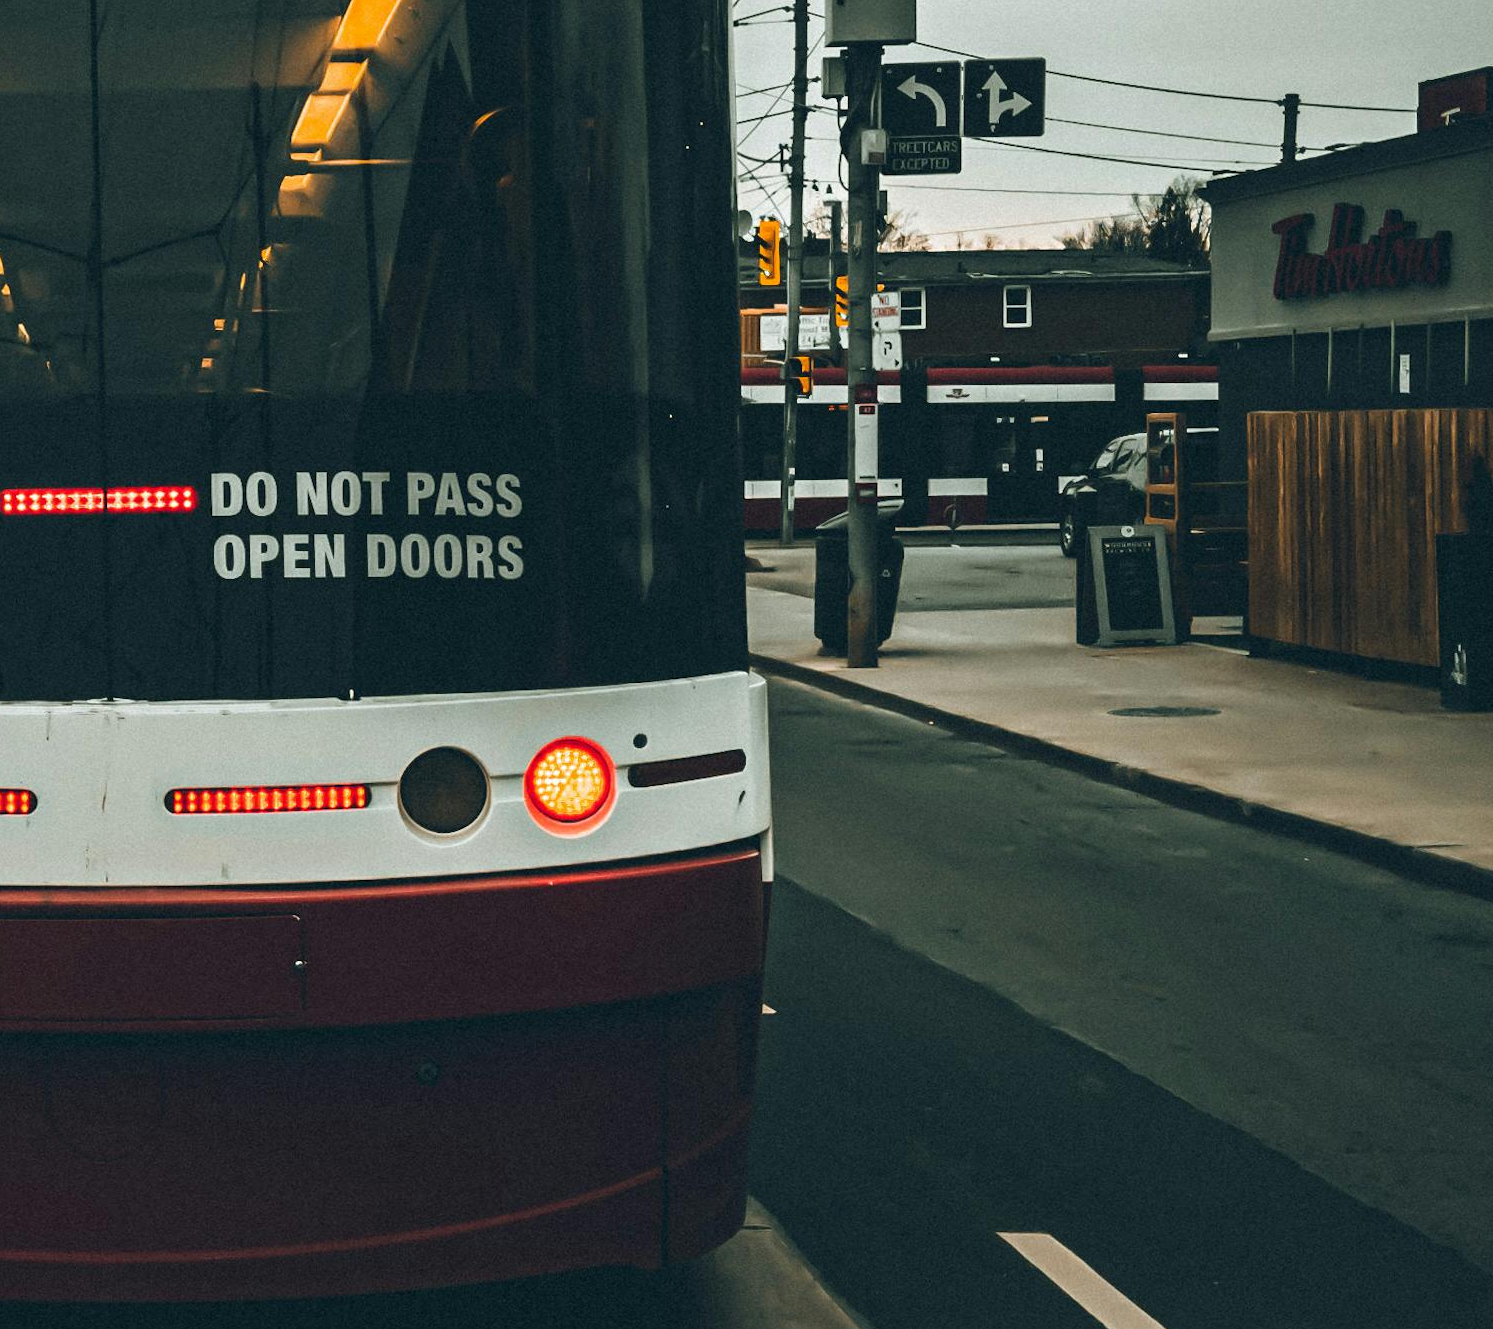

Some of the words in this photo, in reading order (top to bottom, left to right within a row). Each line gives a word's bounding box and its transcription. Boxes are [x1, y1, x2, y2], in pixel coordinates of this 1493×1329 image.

[891, 141, 958, 153] TREETCARS
[892, 157, 950, 171] EXCEPTED
[1271, 212, 1329, 300] Tim
[1324, 201, 1453, 294] Hortons
[211, 472, 278, 517] DO
[296, 472, 391, 517] NOT
[407, 472, 524, 517] PASS
[213, 533, 346, 580] OPEN
[366, 533, 525, 580] DOORS
